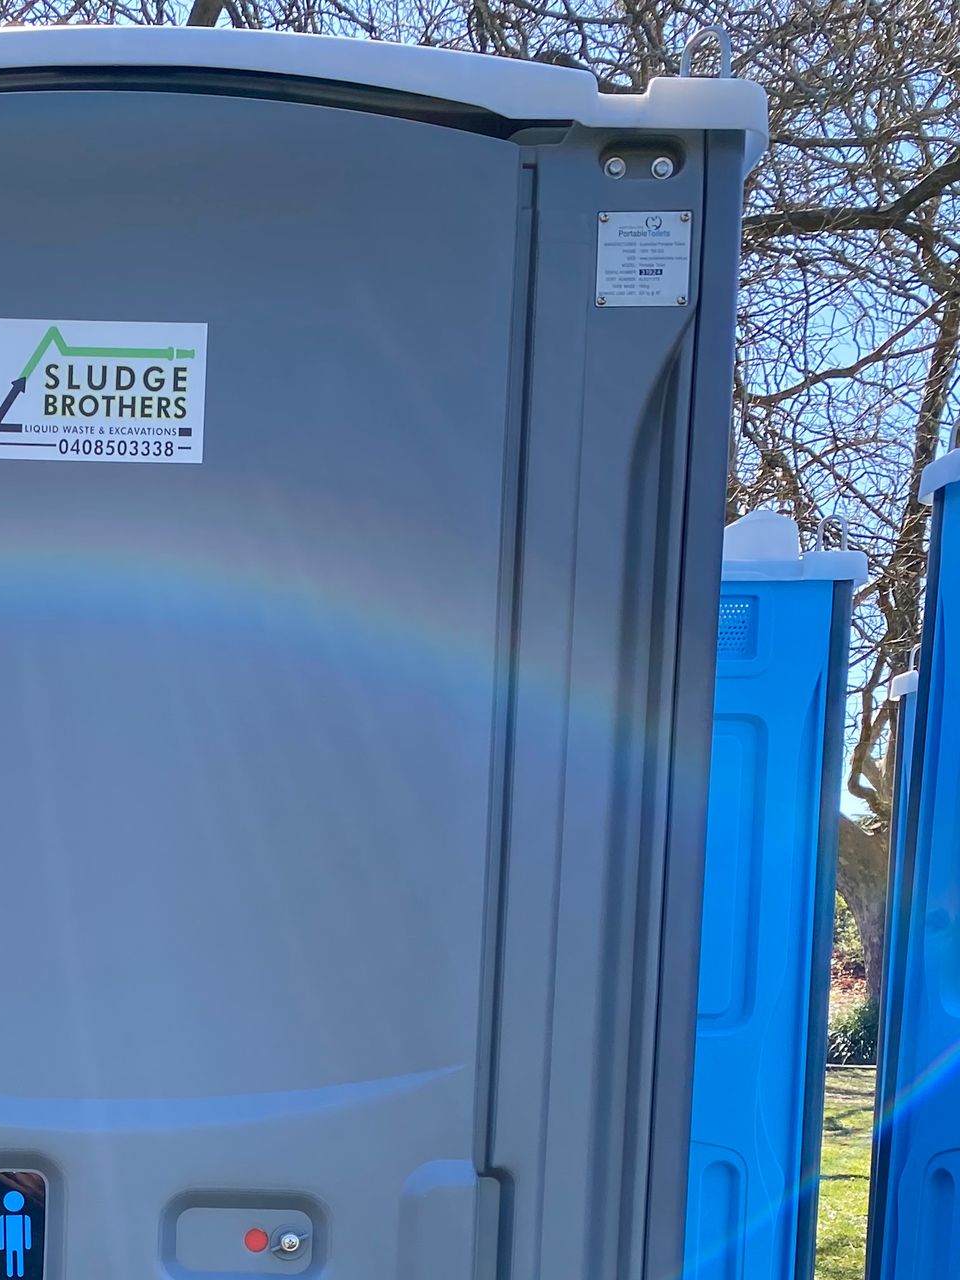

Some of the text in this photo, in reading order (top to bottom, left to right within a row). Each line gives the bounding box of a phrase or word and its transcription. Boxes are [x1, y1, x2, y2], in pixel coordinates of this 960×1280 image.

[44, 363, 188, 392] SLUDGE
[43, 394, 187, 419] BROTHERS
[24, 424, 177, 436] LIQUID WASTE & EXCAVATIONS
[58, 439, 174, 457] 0408503338
